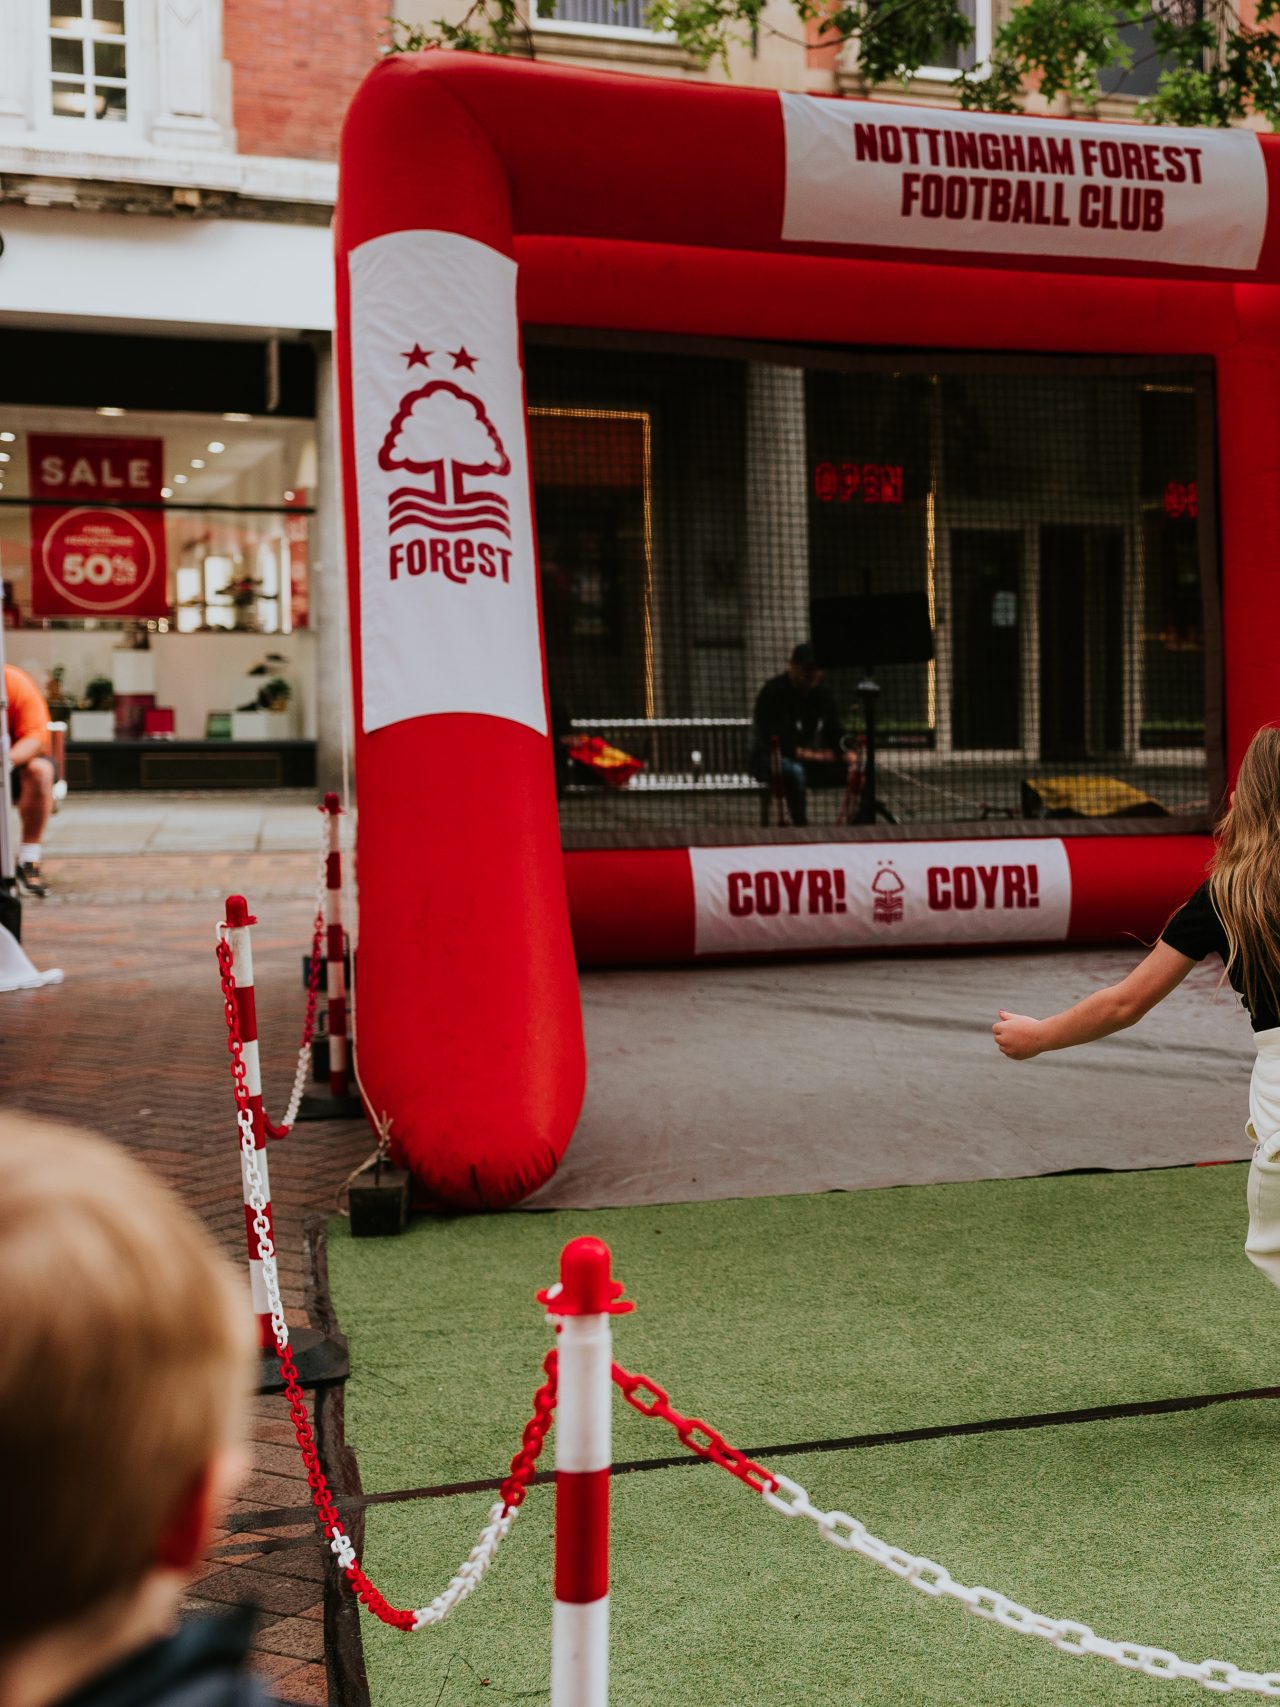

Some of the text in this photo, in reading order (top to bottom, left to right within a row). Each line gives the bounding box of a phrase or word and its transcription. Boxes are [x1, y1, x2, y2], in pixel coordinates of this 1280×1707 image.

[853, 122, 1203, 185] NOTTINGHAM FOREST
[901, 172, 1165, 232] FOOTBALL CLUB
[41, 457, 151, 488] SALE
[815, 463, 904, 503] OPEN
[63, 553, 137, 585] 50%
[728, 864, 1040, 918] COYR! COYR!
